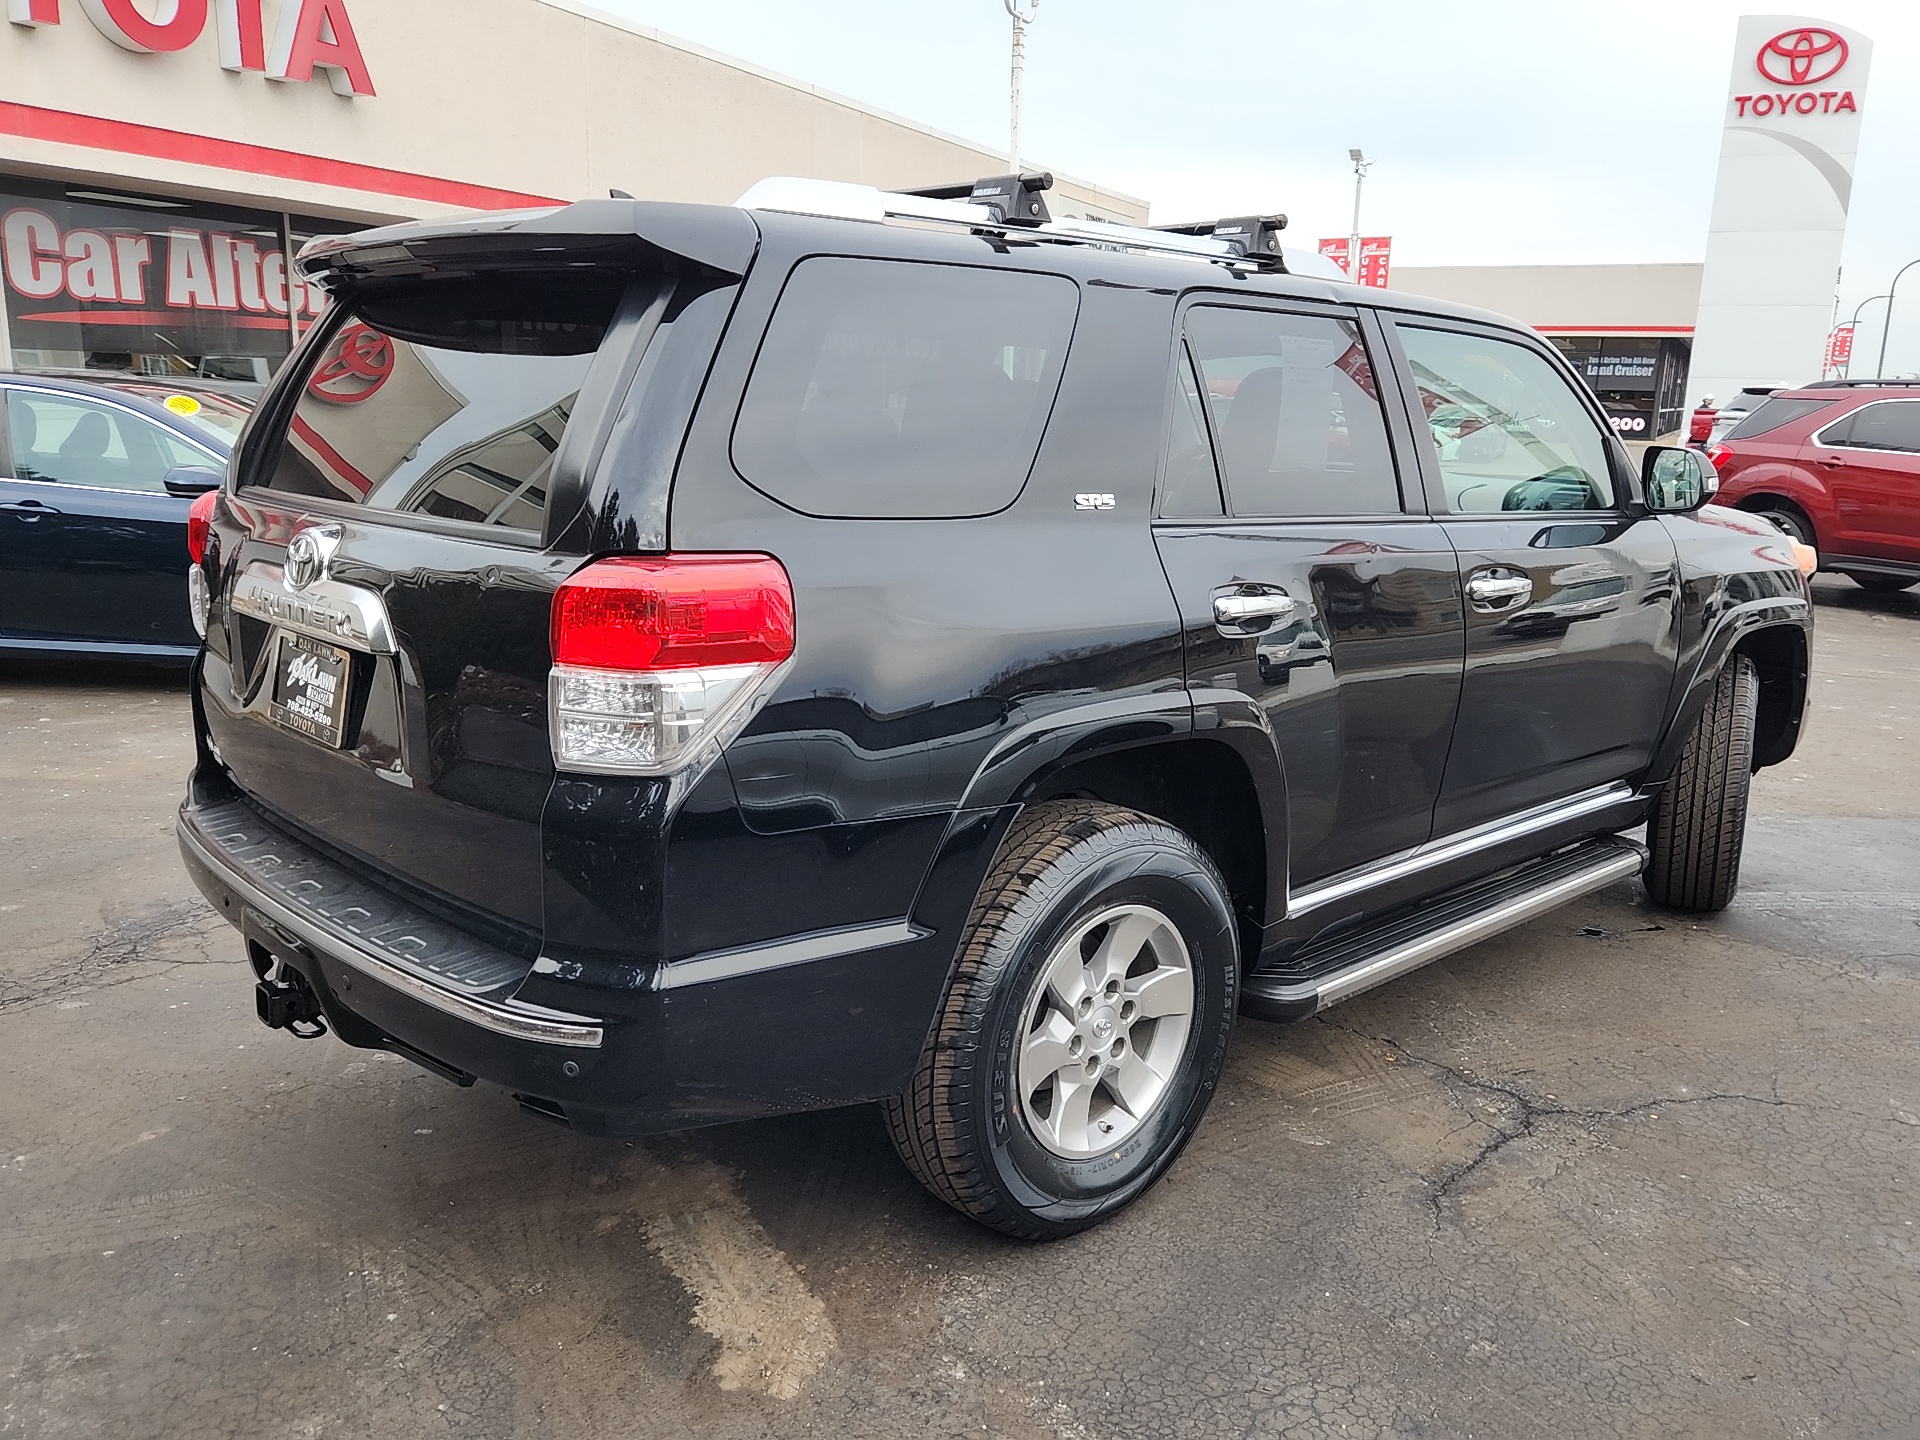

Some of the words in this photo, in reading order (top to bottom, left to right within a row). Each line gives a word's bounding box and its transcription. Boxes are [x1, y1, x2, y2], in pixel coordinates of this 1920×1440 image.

[8, 0, 376, 98] OTA
[1735, 91, 1857, 117] TOYOTA
[2, 208, 151, 304] Car
[1587, 365, 1613, 376] Land
[1615, 365, 1654, 377] Cruiser
[1620, 356, 1632, 364] The
[1633, 356, 1641, 364] All
[1642, 356, 1656, 365] New
[1073, 493, 1115, 511] SR5
[298, 639, 313, 655] OAK
[312, 641, 332, 661] LAWN
[289, 713, 316, 734] TOYOTA
